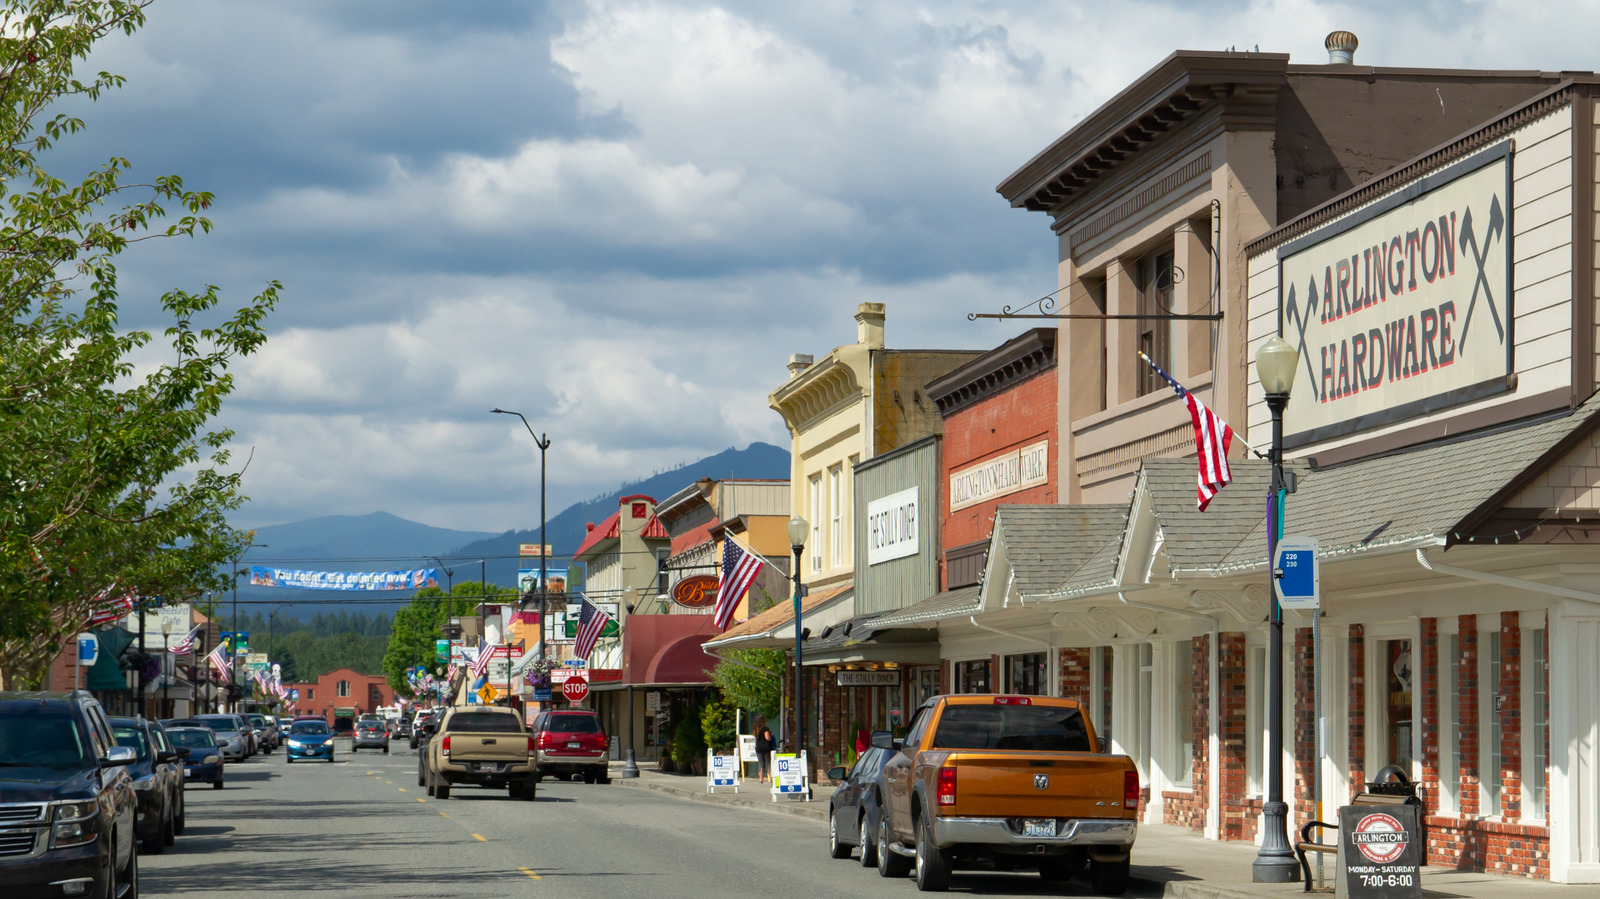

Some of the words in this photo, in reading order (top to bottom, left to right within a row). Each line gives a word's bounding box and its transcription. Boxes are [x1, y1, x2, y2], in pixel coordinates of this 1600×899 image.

[1321, 211, 1456, 325] ARLINGTON
[1320, 300, 1456, 404] HARDWARE
[952, 466, 994, 504] ARLINGTON
[998, 449, 1044, 489] HARDWARE
[870, 514, 880, 550] THE
[881, 507, 899, 547] STILLY
[900, 503, 915, 542] DINER
[274, 569, 292, 580] You
[328, 573, 345, 583] Get
[677, 580, 719, 602] Bistr
[843, 673, 854, 682] THE
[856, 673, 876, 683] STILLY
[877, 673, 894, 683] DINER
[565, 683, 587, 693] STOP
[714, 758, 722, 766] 10
[779, 761, 788, 770] 10
[1357, 833, 1403, 842] ARLINGTON
[1360, 874, 1413, 887] 7:00-6:00
